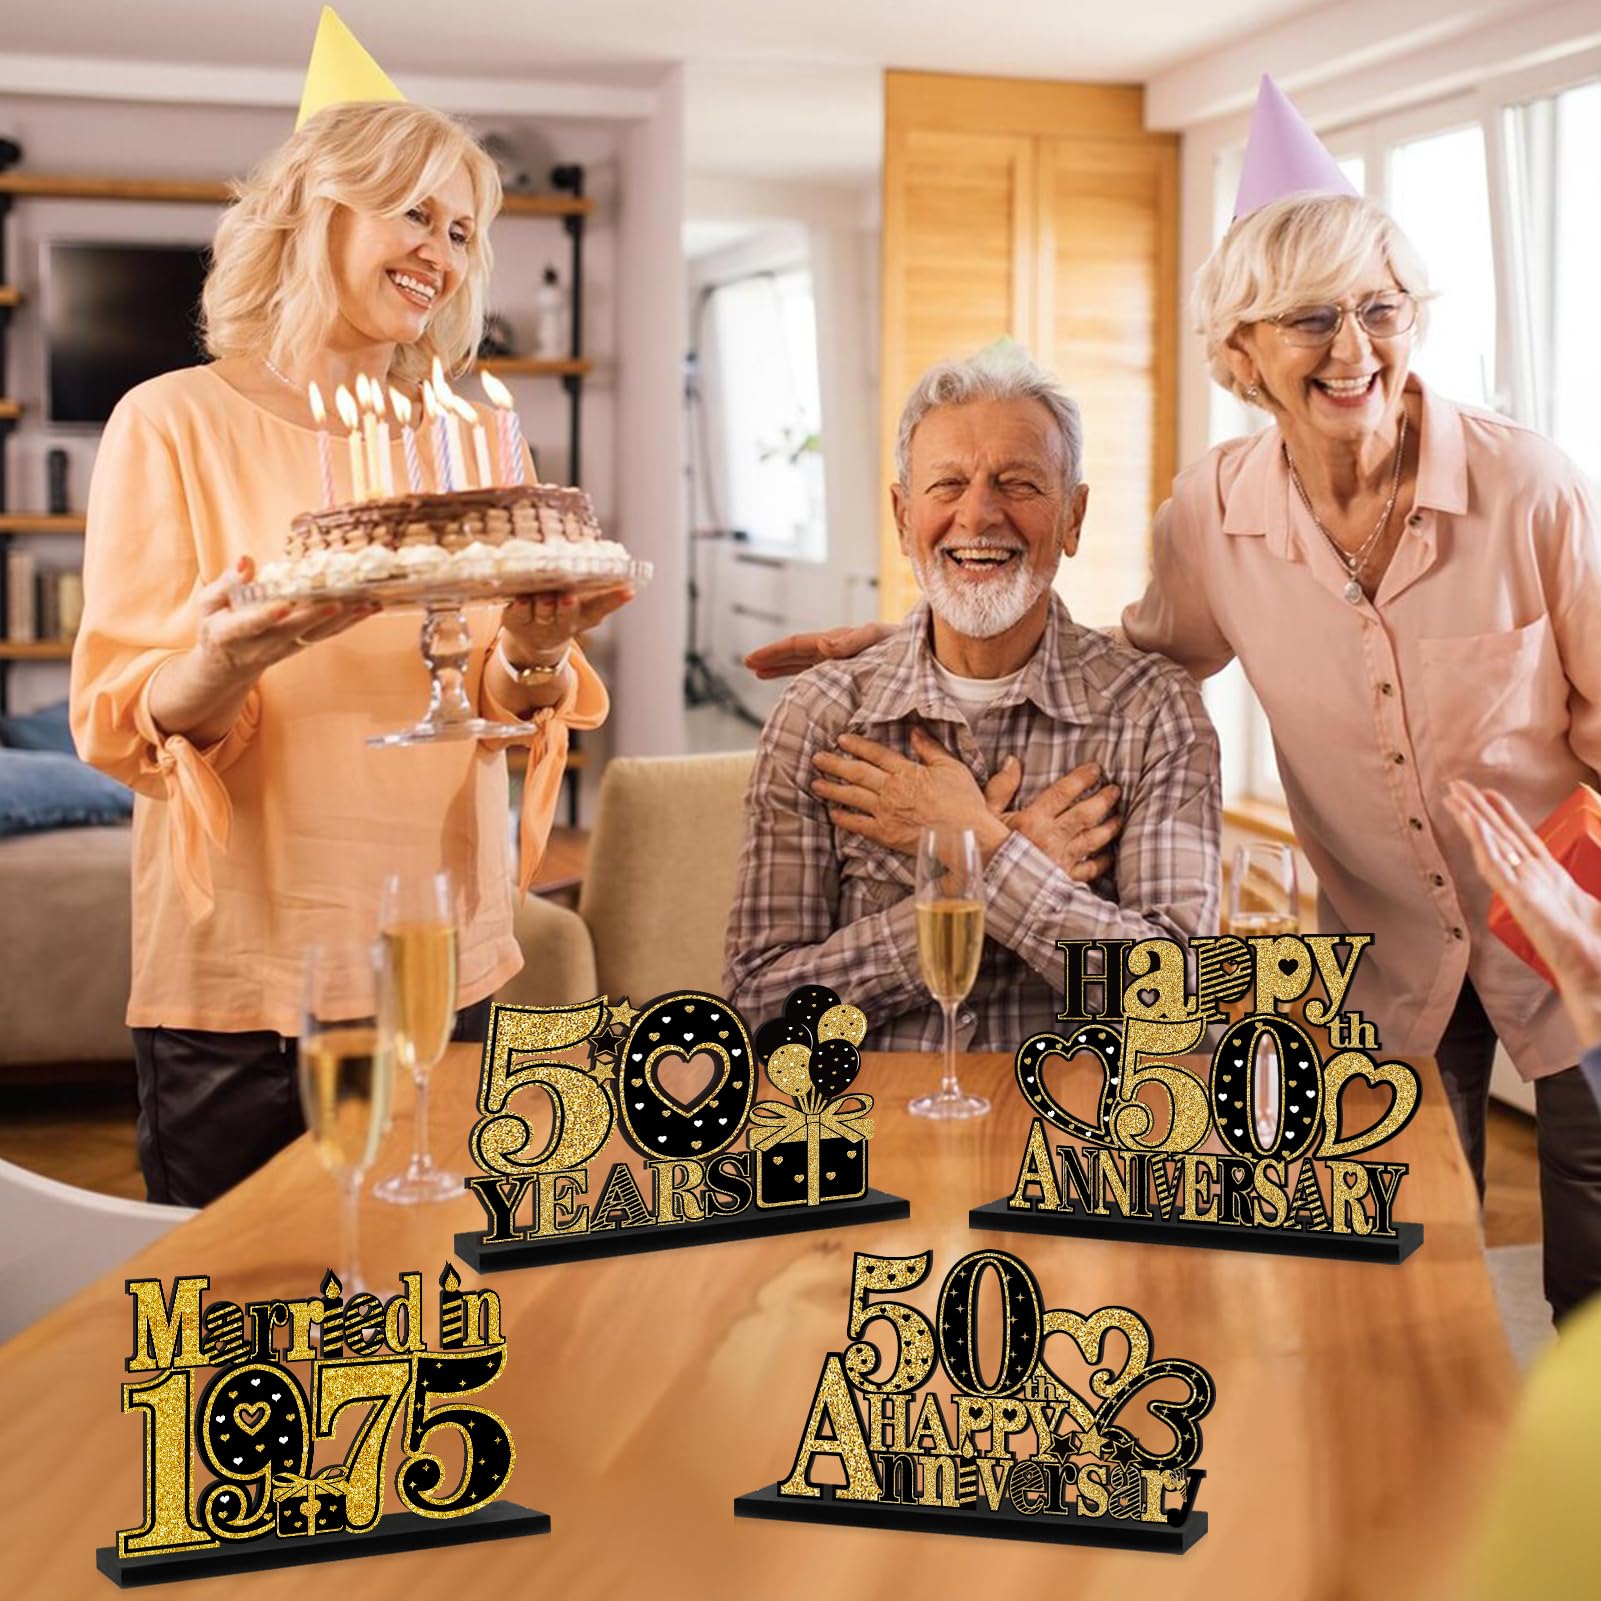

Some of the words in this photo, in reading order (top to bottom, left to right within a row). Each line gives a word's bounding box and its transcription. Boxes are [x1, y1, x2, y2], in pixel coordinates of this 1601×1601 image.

[1056, 933, 1375, 1025] Happy
[470, 990, 758, 1176] 50
[465, 1153, 755, 1246] YEARS
[1008, 1118, 1408, 1238] ANNIVERSARY
[125, 1271, 427, 1372] Married
[439, 1261, 506, 1349] in
[118, 1346, 518, 1559] 1975
[862, 1392, 1072, 1463] HAPPY
